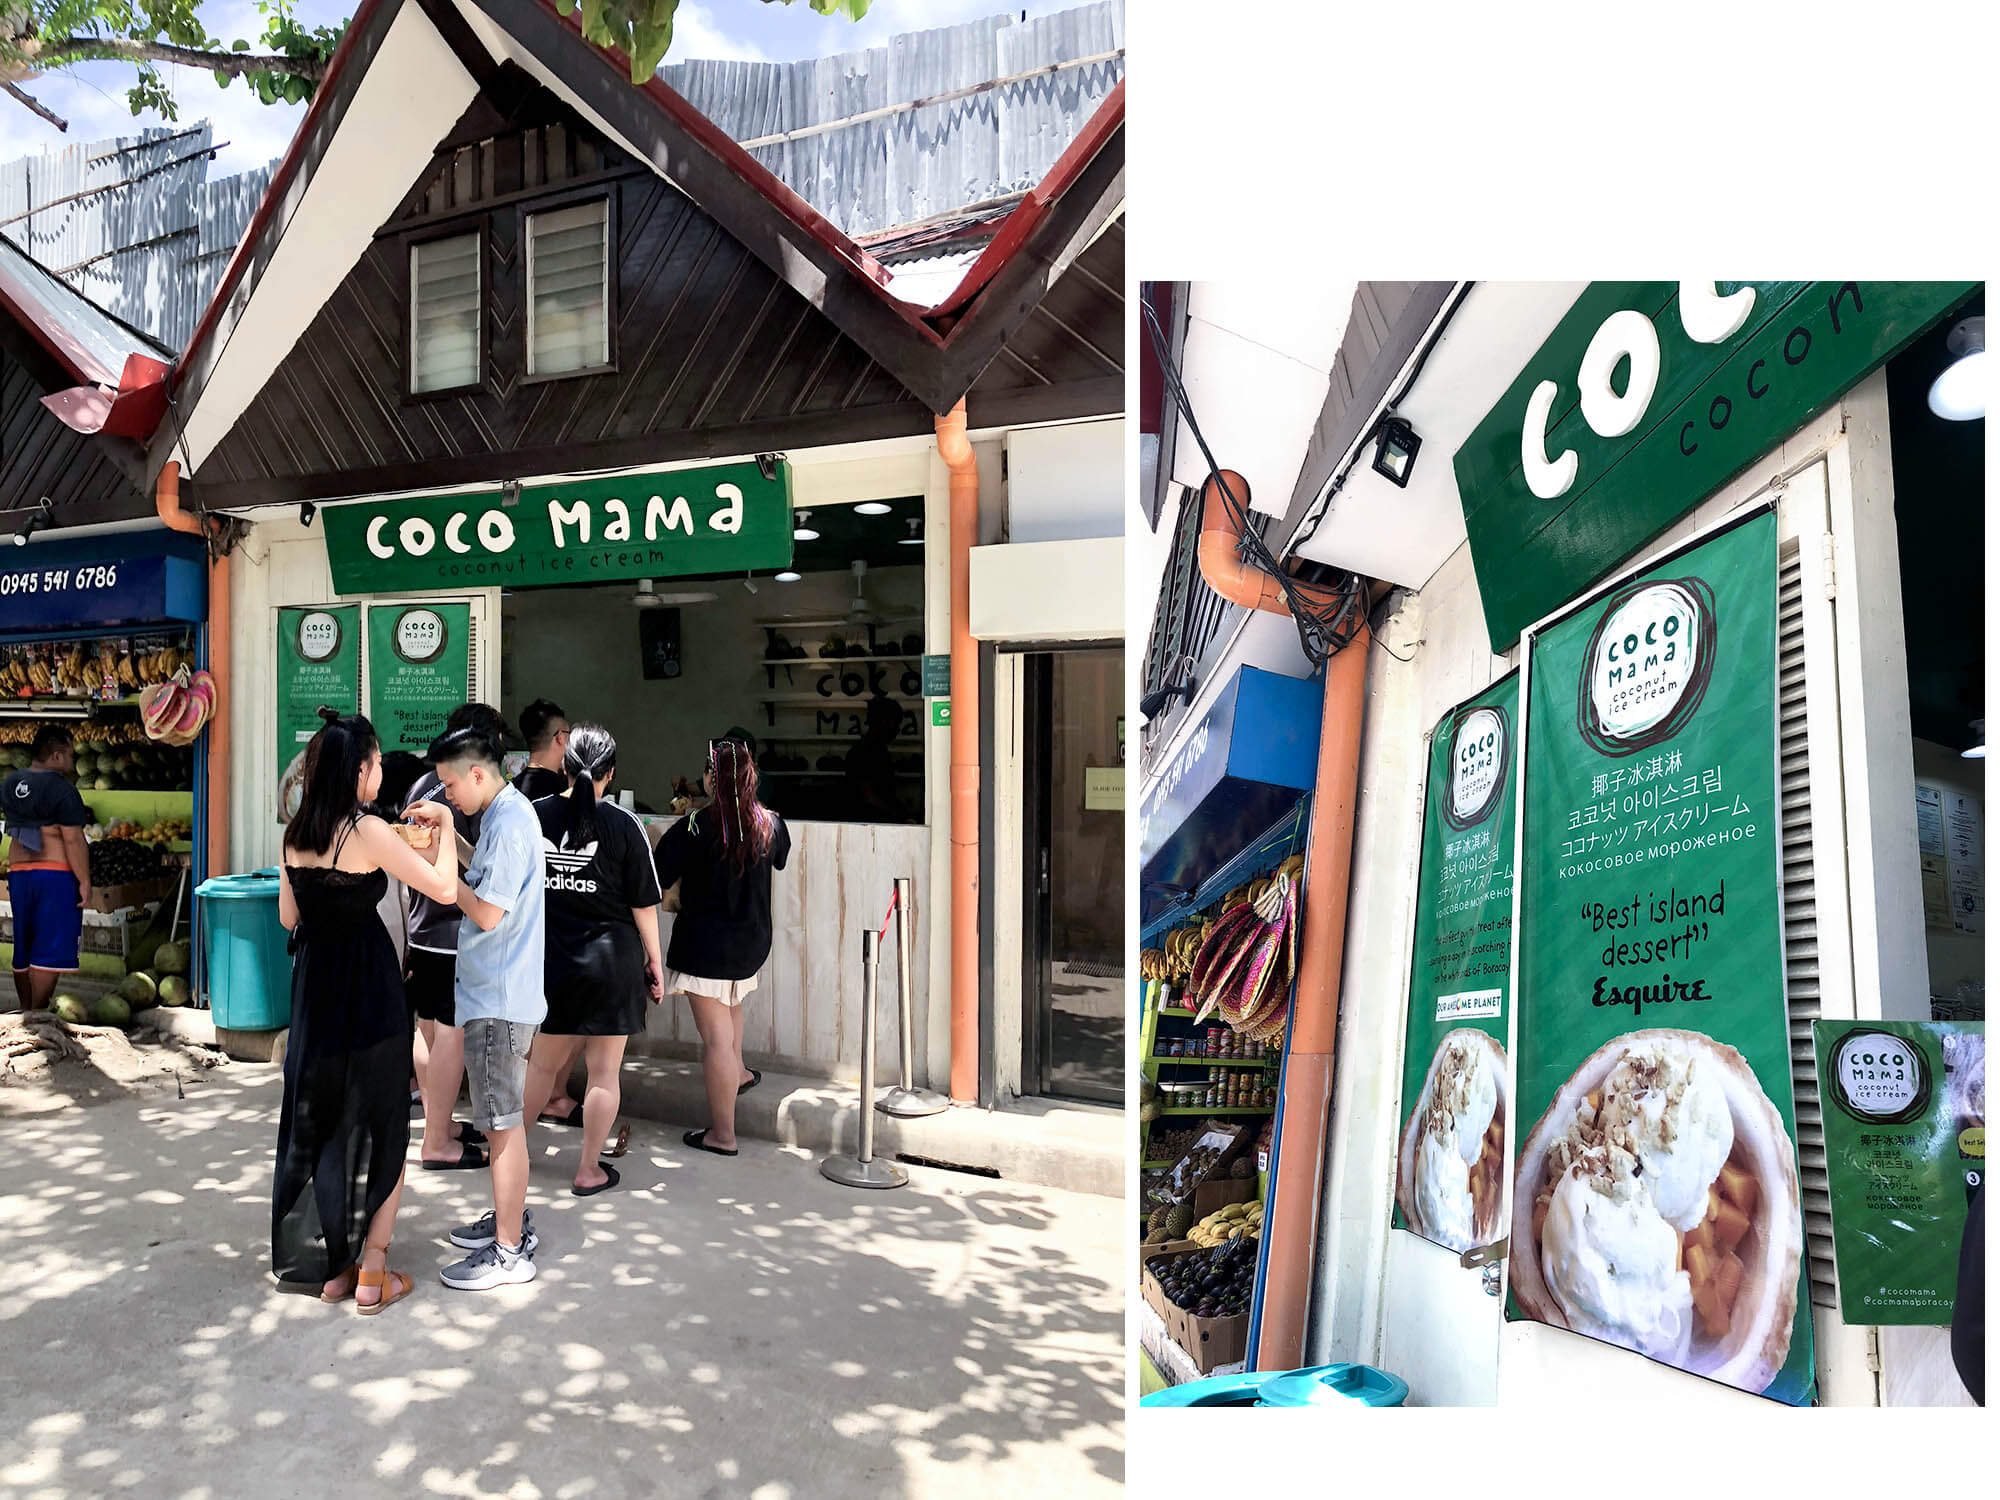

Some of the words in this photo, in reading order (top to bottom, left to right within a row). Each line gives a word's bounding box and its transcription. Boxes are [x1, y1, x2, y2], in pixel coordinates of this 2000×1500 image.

[366, 509, 516, 560] COCO
[438, 553, 526, 577] coconut
[541, 555, 574, 572] ice
[590, 550, 664, 569] cream
[1, 573, 38, 595] 0945
[44, 570, 69, 592] 541
[76, 565, 116, 589] 6786
[306, 624, 331, 632] COCO
[405, 622, 435, 630] COCO
[1608, 615, 1680, 662] COCO
[1609, 701, 1628, 716] ice
[1635, 681, 1678, 704] cream
[1612, 668, 1667, 703] coconut
[816, 710, 918, 736] Maa
[400, 733, 434, 746] Esqui
[1461, 732, 1494, 763] COCO
[1567, 797, 1617, 831] 코코넛
[1623, 765, 1723, 816] 아이스크림
[1560, 826, 1629, 858] ココナッツ
[1633, 794, 1751, 842] アイスクリーム
[1459, 842, 1499, 875] 아이스림
[1559, 849, 1645, 880] кокосовое
[1647, 823, 1757, 860] мороженое
[1649, 878, 1725, 924] island
[1472, 962, 1482, 977] of
[1473, 995, 1501, 1009] PLANET
[1591, 973, 1713, 1016] Esquire
[1850, 1053, 1905, 1066] COCO
[1855, 1090, 1871, 1098] ice
[1857, 1083, 1900, 1091] coconut
[1970, 1173, 1977, 1184] 3
[1879, 1286, 1936, 1296] #cocomama
